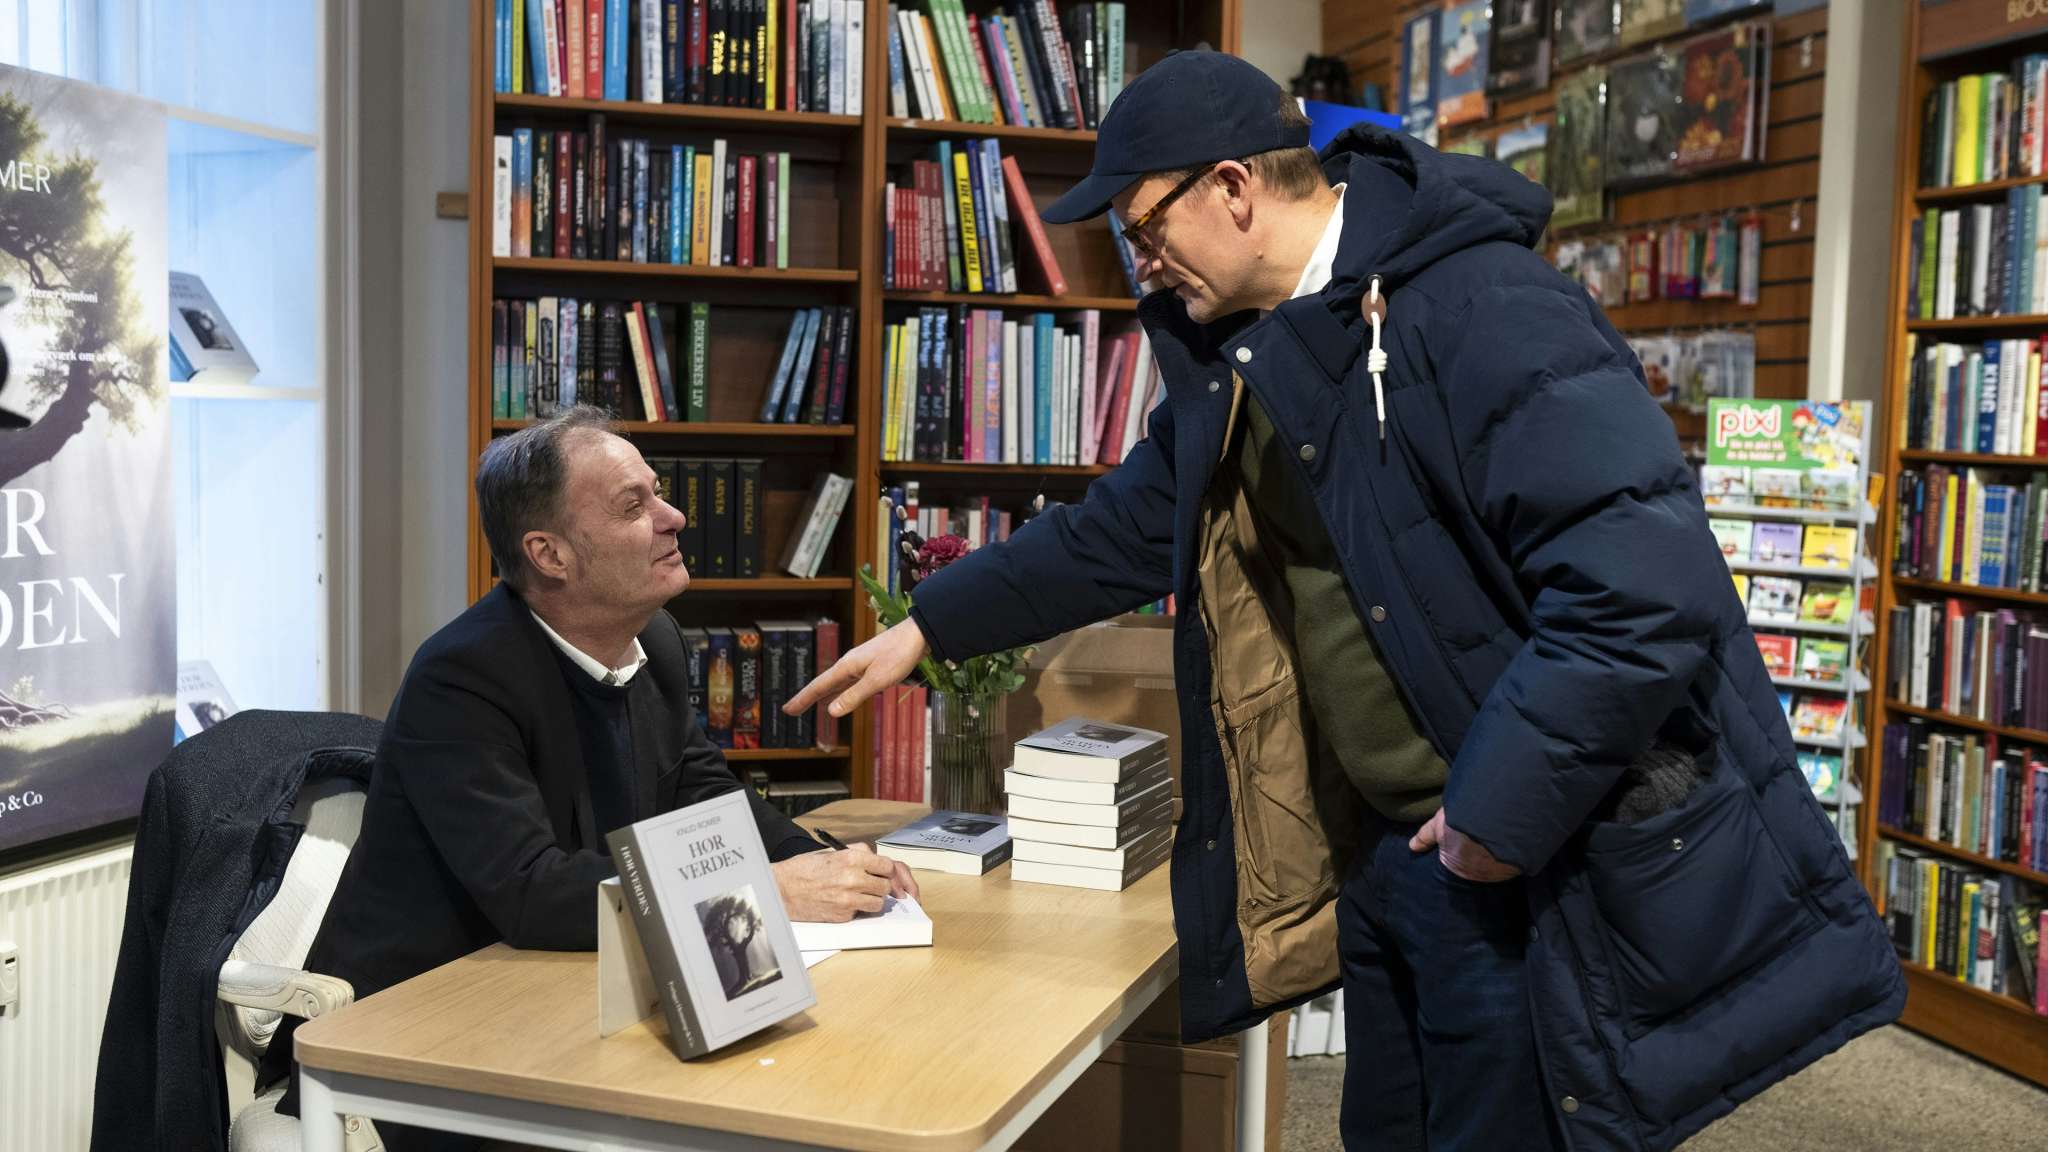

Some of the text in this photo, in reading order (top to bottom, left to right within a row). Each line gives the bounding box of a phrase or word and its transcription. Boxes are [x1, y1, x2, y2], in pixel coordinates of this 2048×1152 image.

[0, 159, 51, 195] MER
[692, 319, 705, 409] DUKKERNES LIV
[1981, 363, 1999, 413] KING
[1716, 403, 1781, 448] pixi
[715, 477, 725, 515] ARVEN
[744, 478, 753, 534] MURTAGH
[2, 487, 56, 558] R
[0, 573, 126, 652] EN
[8, 795, 21, 811] &
[22, 791, 43, 807] Co
[677, 846, 746, 881] VERDEN
[688, 834, 726, 858] HØR
